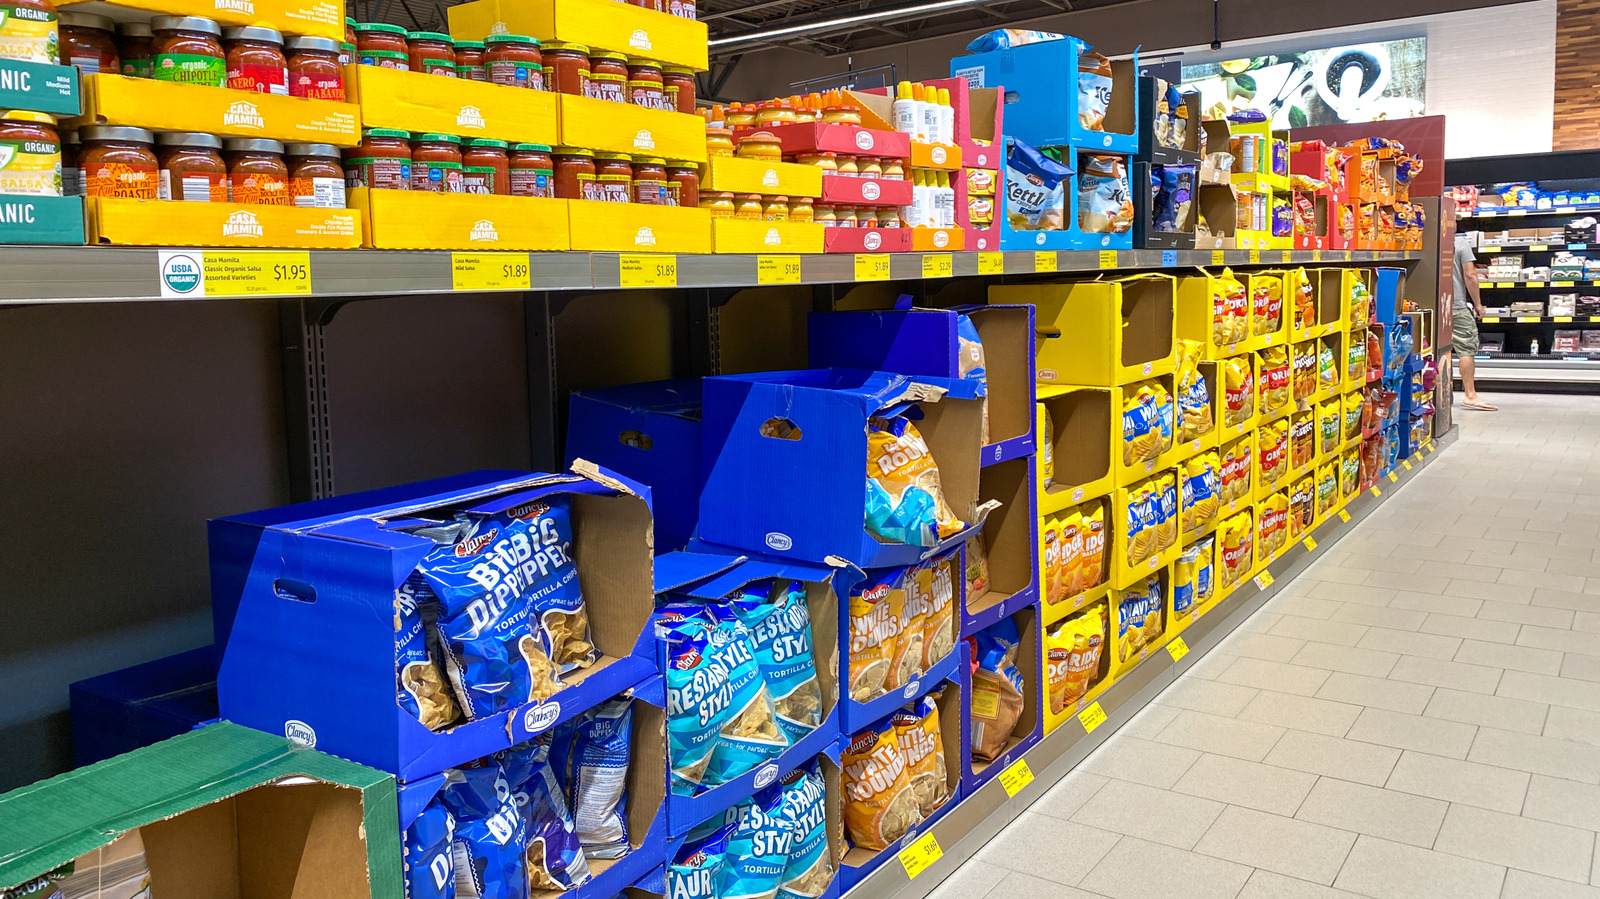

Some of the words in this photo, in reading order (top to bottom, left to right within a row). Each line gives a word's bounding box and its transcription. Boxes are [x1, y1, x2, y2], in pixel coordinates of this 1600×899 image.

[215, 0, 254, 14] MAMITA
[16, 8, 49, 21] ORGANIC
[182, 60, 207, 71] organic
[173, 69, 217, 83] CHIPOTLE
[317, 80, 338, 89] organic
[230, 104, 257, 116] CASA
[223, 113, 264, 128] MAMITA
[457, 115, 485, 128] MAMITA
[25, 142, 55, 153] ORGANIC
[120, 170, 146, 183] organic
[1015, 199, 1032, 209] CHIPS
[229, 214, 257, 225] CASA
[223, 224, 264, 237] MAMITA
[470, 230, 498, 241] MAMITA
[171, 264, 193, 273] USDA
[224, 265, 246, 273] Organic
[273, 263, 307, 281] $1.95
[503, 264, 527, 278] $1.89
[656, 264, 675, 277] $1.89
[785, 263, 800, 274] $1.89
[169, 275, 196, 283] ORGANIC
[454, 527, 499, 558] Clancy's
[767, 534, 791, 549] Clancy's
[1061, 531, 1083, 560] IDGE
[711, 640, 752, 676] TYLE
[1069, 646, 1099, 667] RIDG
[768, 663, 806, 679] TORTILLA
[526, 704, 560, 729] Clancy's
[286, 722, 315, 746] Clancy's
[845, 744, 897, 783] WHITE
[865, 791, 895, 808] TORTILLA
[790, 837, 821, 860] TORTILLA
[924, 840, 938, 856] $1.69
[744, 864, 781, 875] TORTILLA
